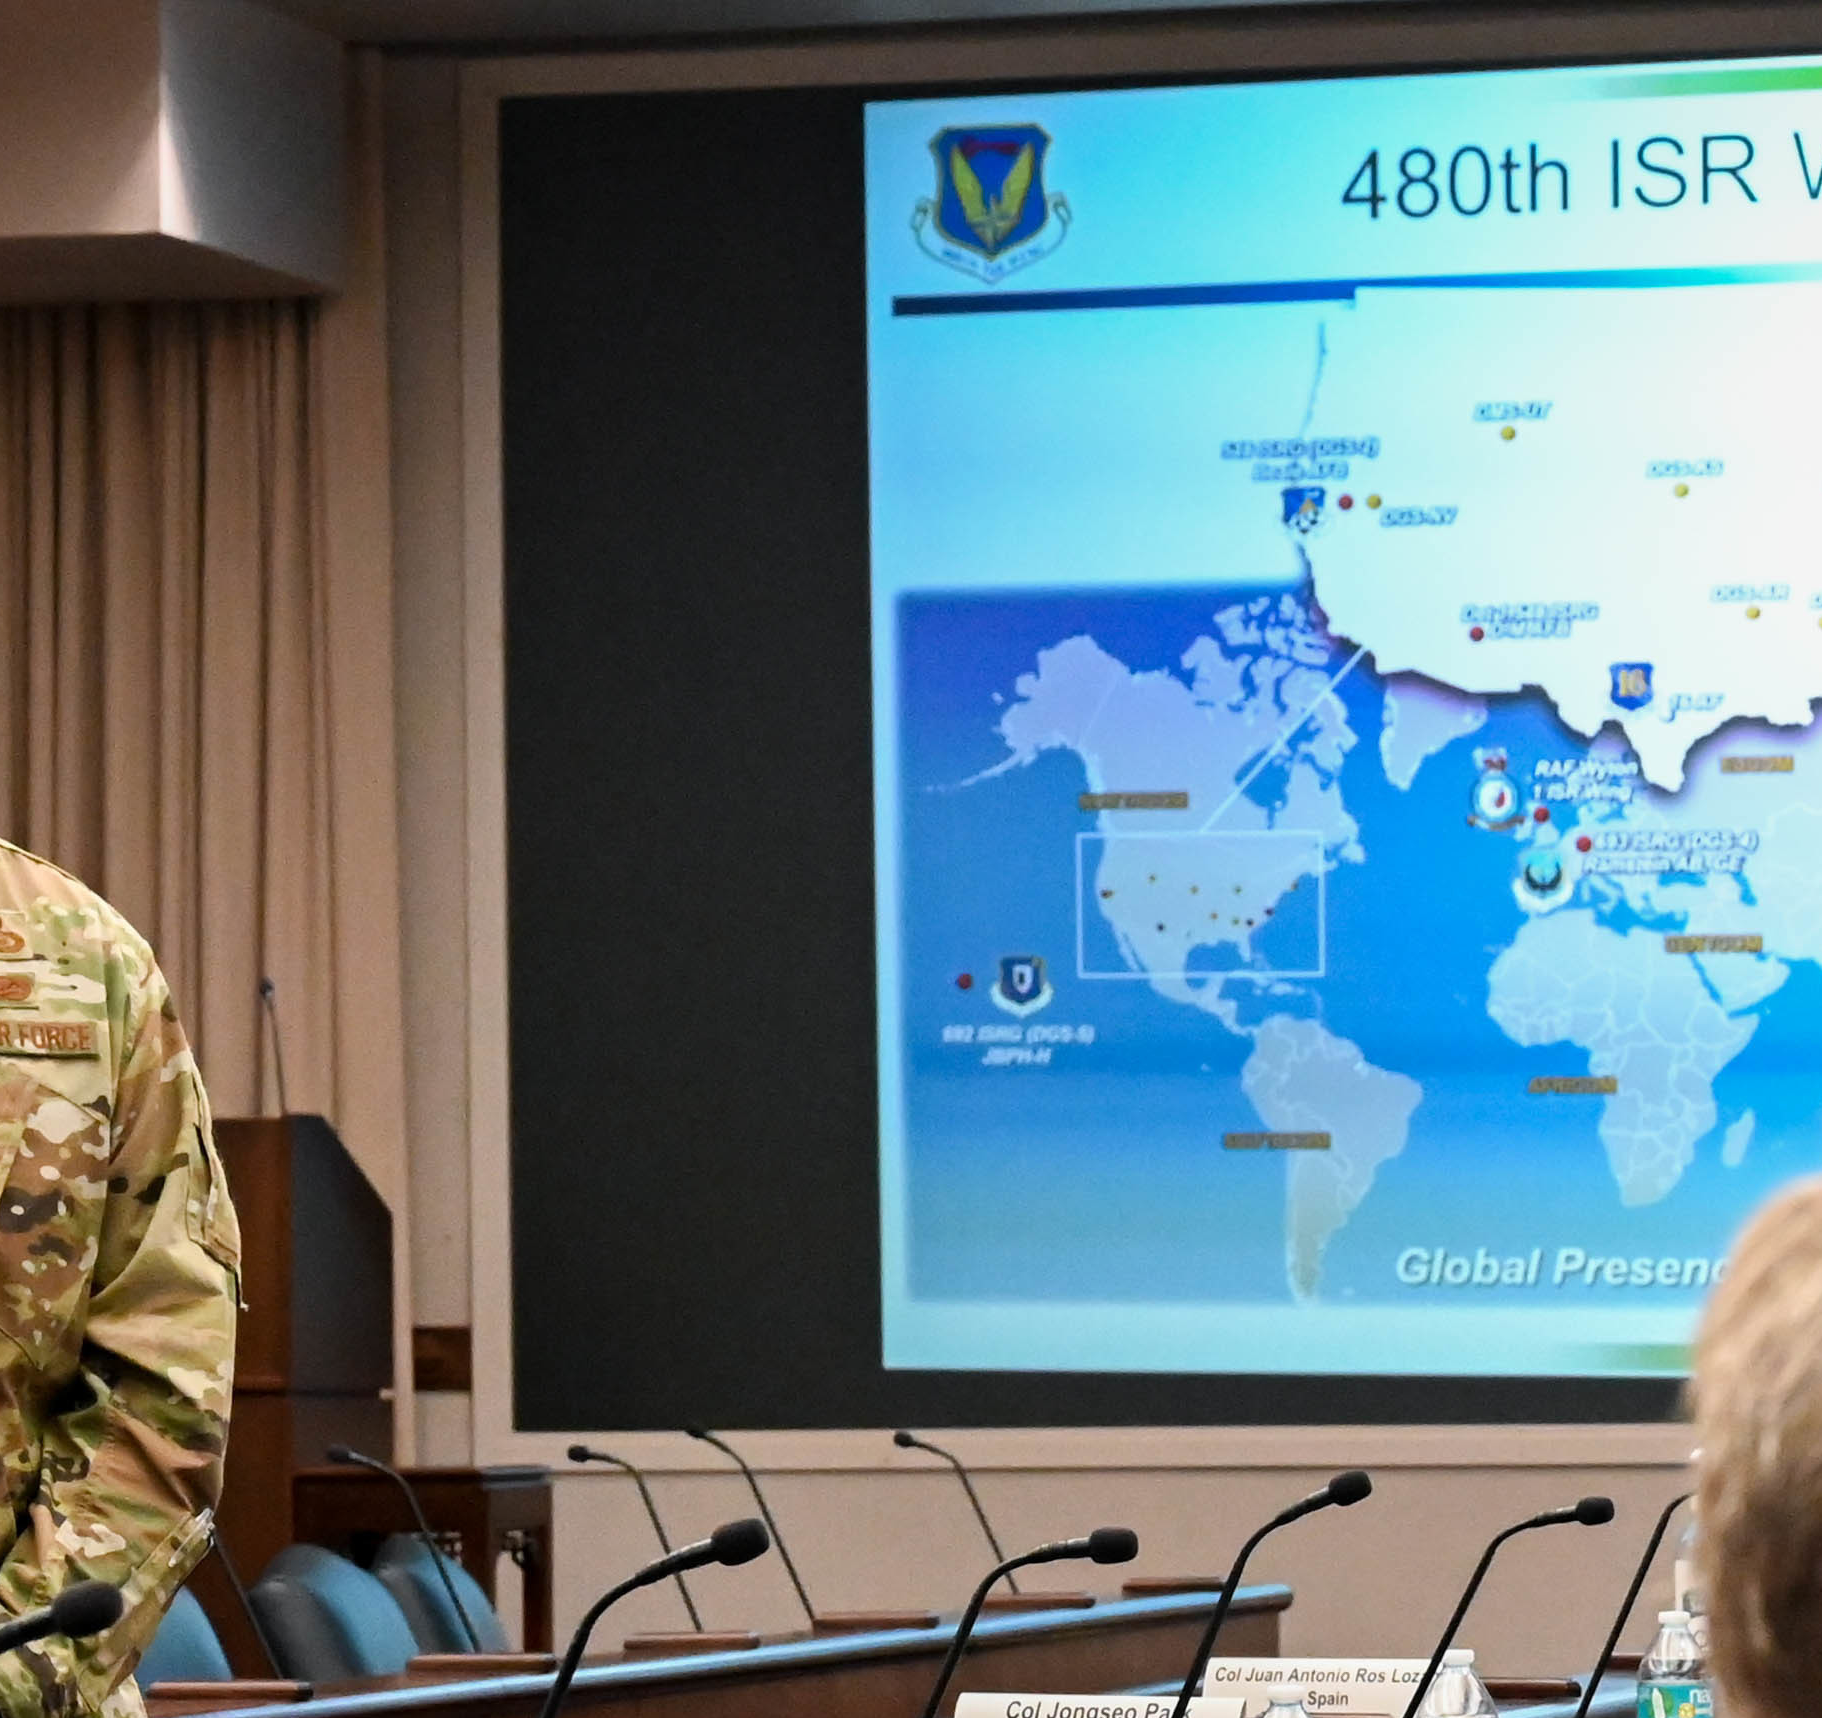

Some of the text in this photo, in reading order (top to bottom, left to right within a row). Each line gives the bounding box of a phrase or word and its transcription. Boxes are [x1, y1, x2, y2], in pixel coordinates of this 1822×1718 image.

[1341, 143, 1570, 219] 480th
[1610, 134, 1759, 209] ISR
[18, 1021, 91, 1050] FORCE
[1395, 1248, 1543, 1286] Global
[1215, 1667, 1241, 1682] Col
[1245, 1667, 1283, 1682] Juan
[1287, 1667, 1350, 1683] Antonio
[1355, 1667, 1385, 1683] Ros
[1307, 1690, 1349, 1709] Spain
